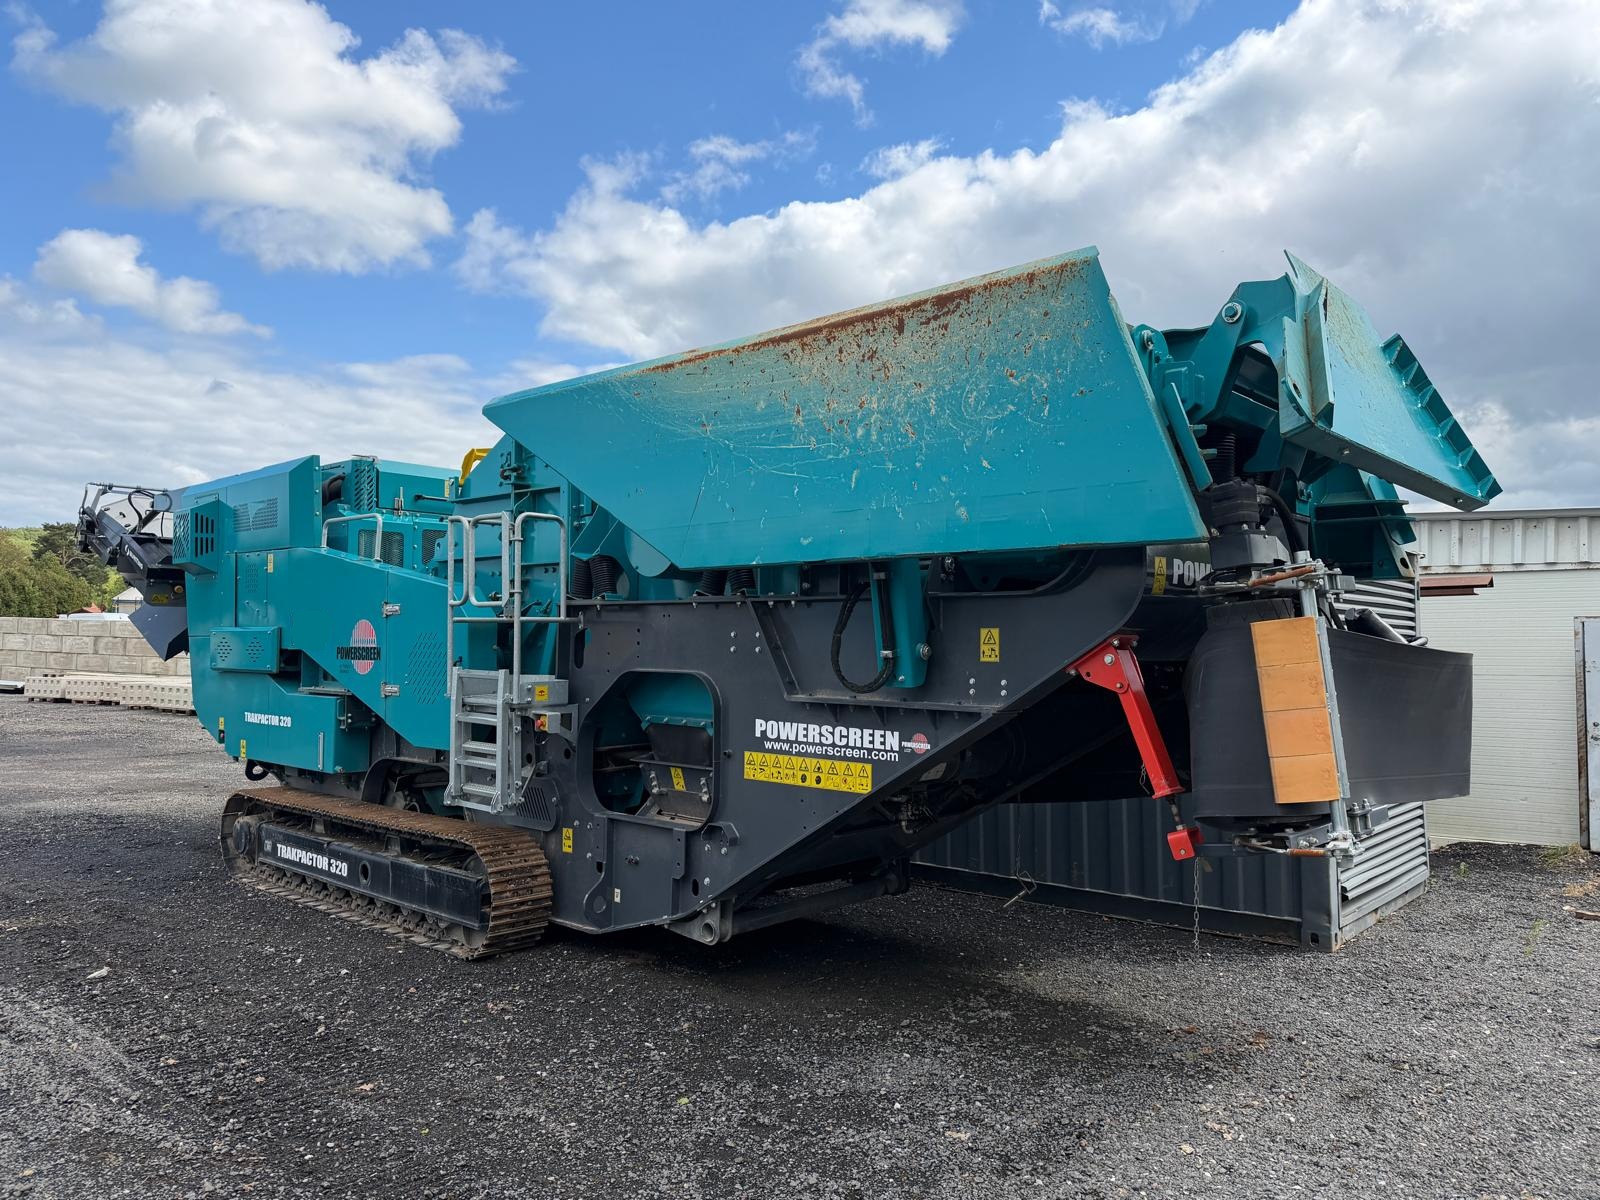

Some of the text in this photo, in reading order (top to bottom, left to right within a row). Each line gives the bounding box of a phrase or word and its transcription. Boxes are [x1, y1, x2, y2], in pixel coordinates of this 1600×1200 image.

[336, 646, 381, 661] POWERSCREEN
[244, 711, 292, 728] TRAKPACTOR 320
[755, 718, 900, 751] POWERSCREEN
[764, 740, 899, 762] www.powerscreen.com
[276, 843, 329, 871] TRAKPACTOR
[330, 858, 348, 877] 320
